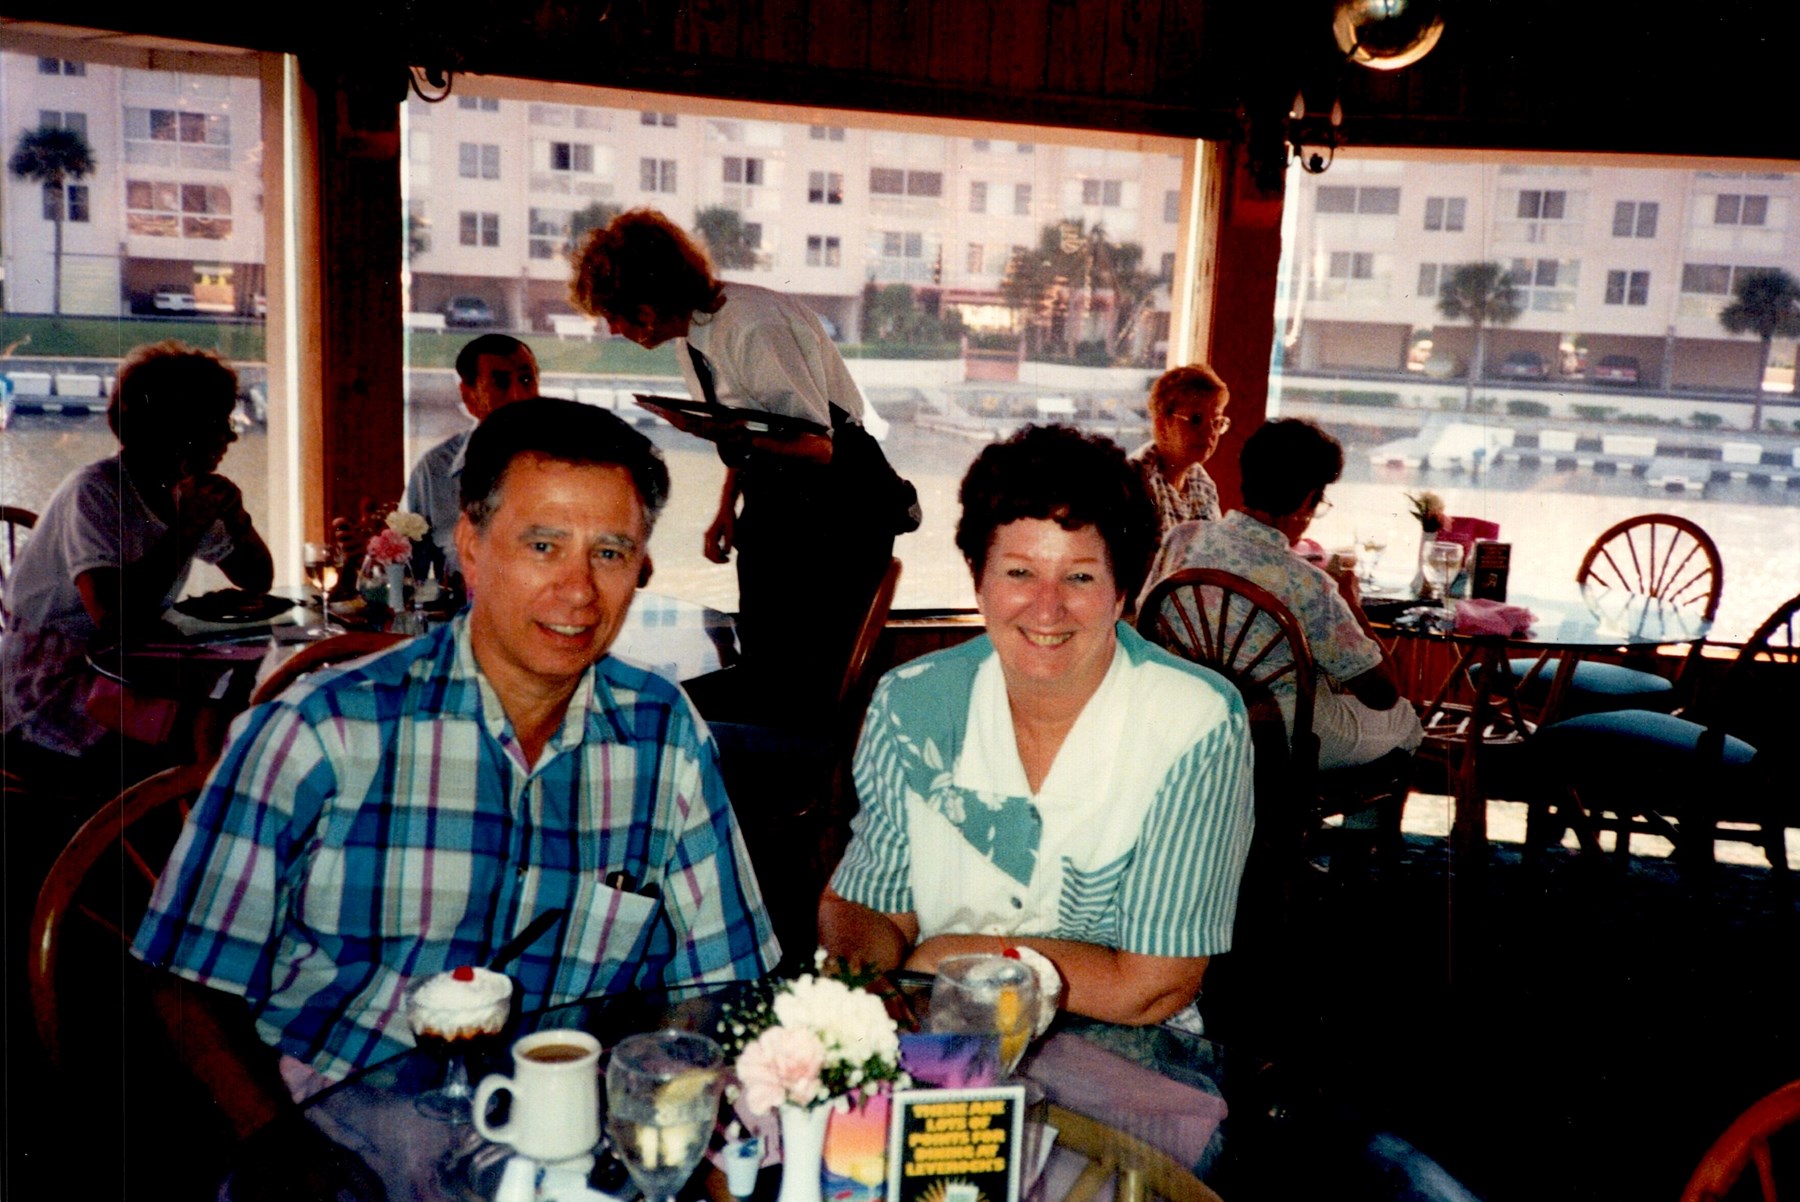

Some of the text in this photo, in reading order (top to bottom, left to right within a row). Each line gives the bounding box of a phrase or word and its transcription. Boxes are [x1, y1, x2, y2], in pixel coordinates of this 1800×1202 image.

[912, 1101, 1006, 1118] THERE ARE
[925, 1115, 992, 1132] LOTS OF
[971, 1128, 1005, 1144] FOR
[976, 1144, 999, 1158] AT
